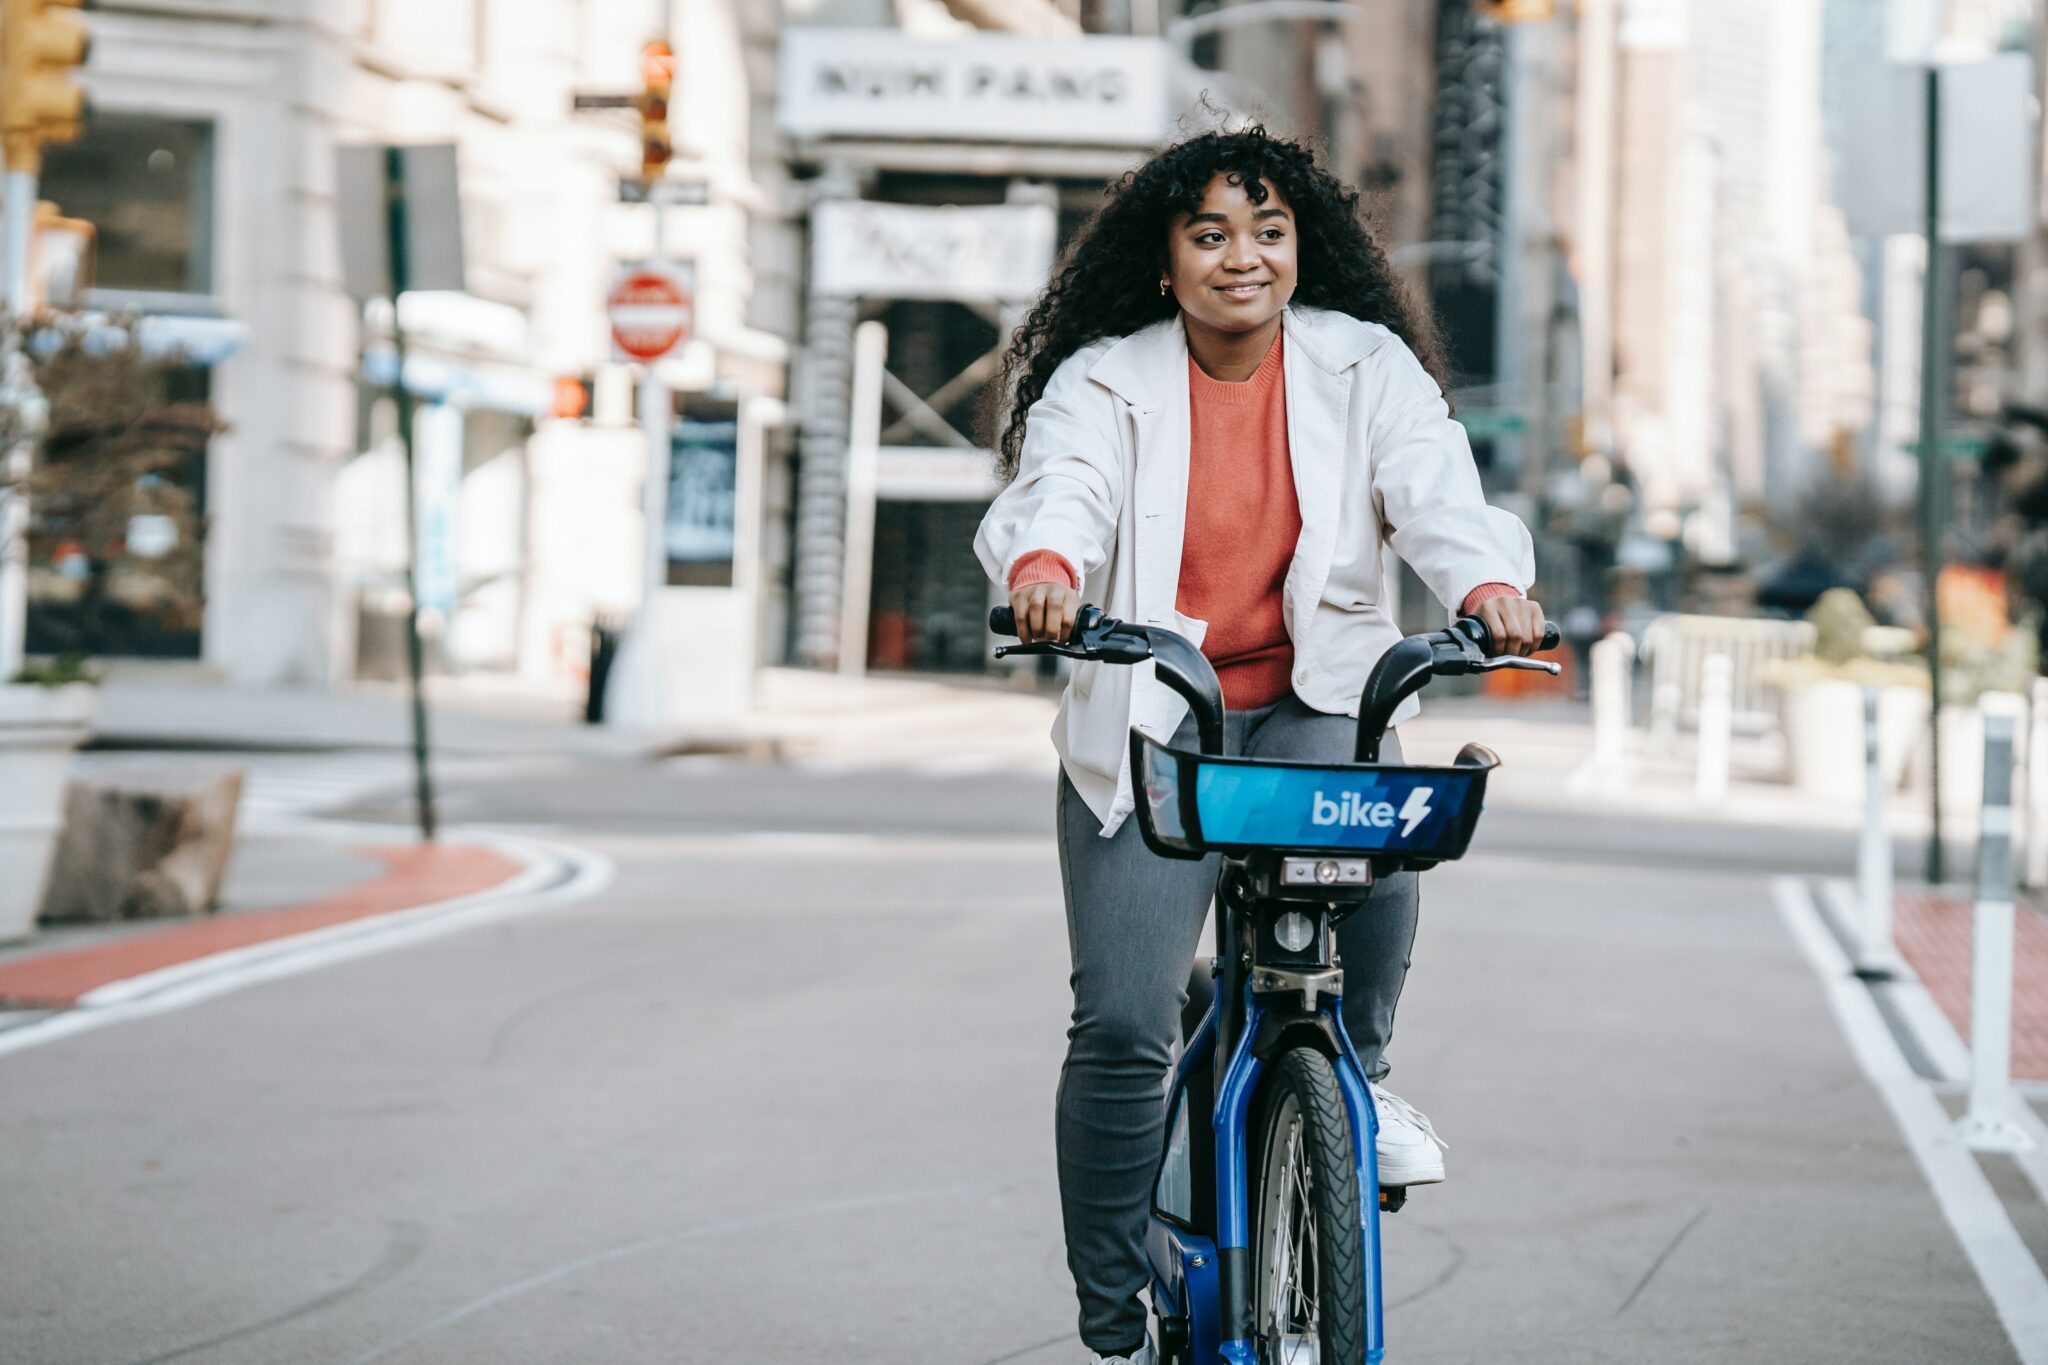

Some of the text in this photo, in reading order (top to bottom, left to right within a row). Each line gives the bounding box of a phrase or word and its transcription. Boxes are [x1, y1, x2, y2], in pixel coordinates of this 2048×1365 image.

[815, 61, 1129, 104] NUM PANG
[1313, 791, 1395, 827] bike
